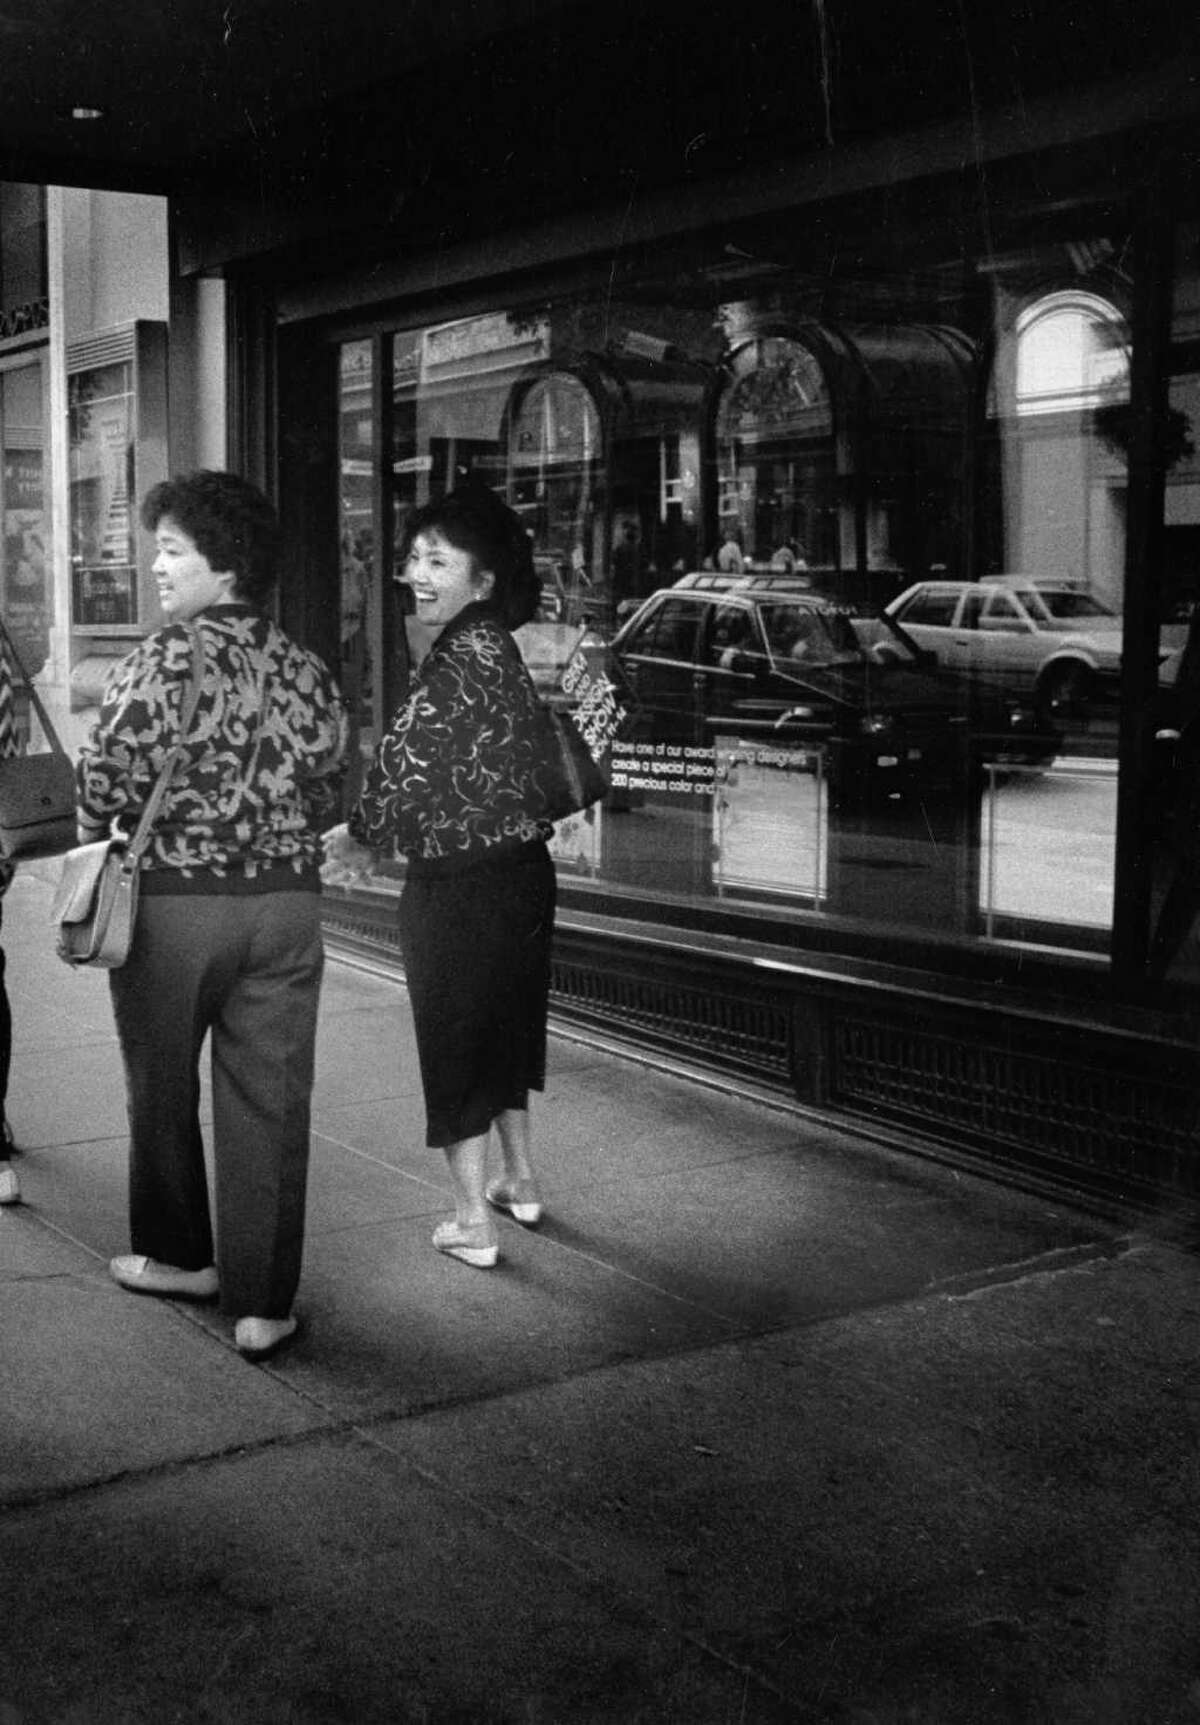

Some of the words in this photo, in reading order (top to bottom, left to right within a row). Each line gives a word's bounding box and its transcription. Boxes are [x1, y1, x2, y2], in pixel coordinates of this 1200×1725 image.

[583, 692, 616, 746] SHOW
[611, 740, 634, 753] Have
[636, 743, 653, 754] one
[656, 743, 666, 756] of
[667, 745, 682, 757] our
[684, 746, 715, 759] award
[611, 759, 641, 771] create
[643, 762, 650, 772] a
[651, 761, 685, 775] special
[686, 763, 714, 777] piece
[629, 776, 667, 791] precious
[668, 779, 693, 793] color
